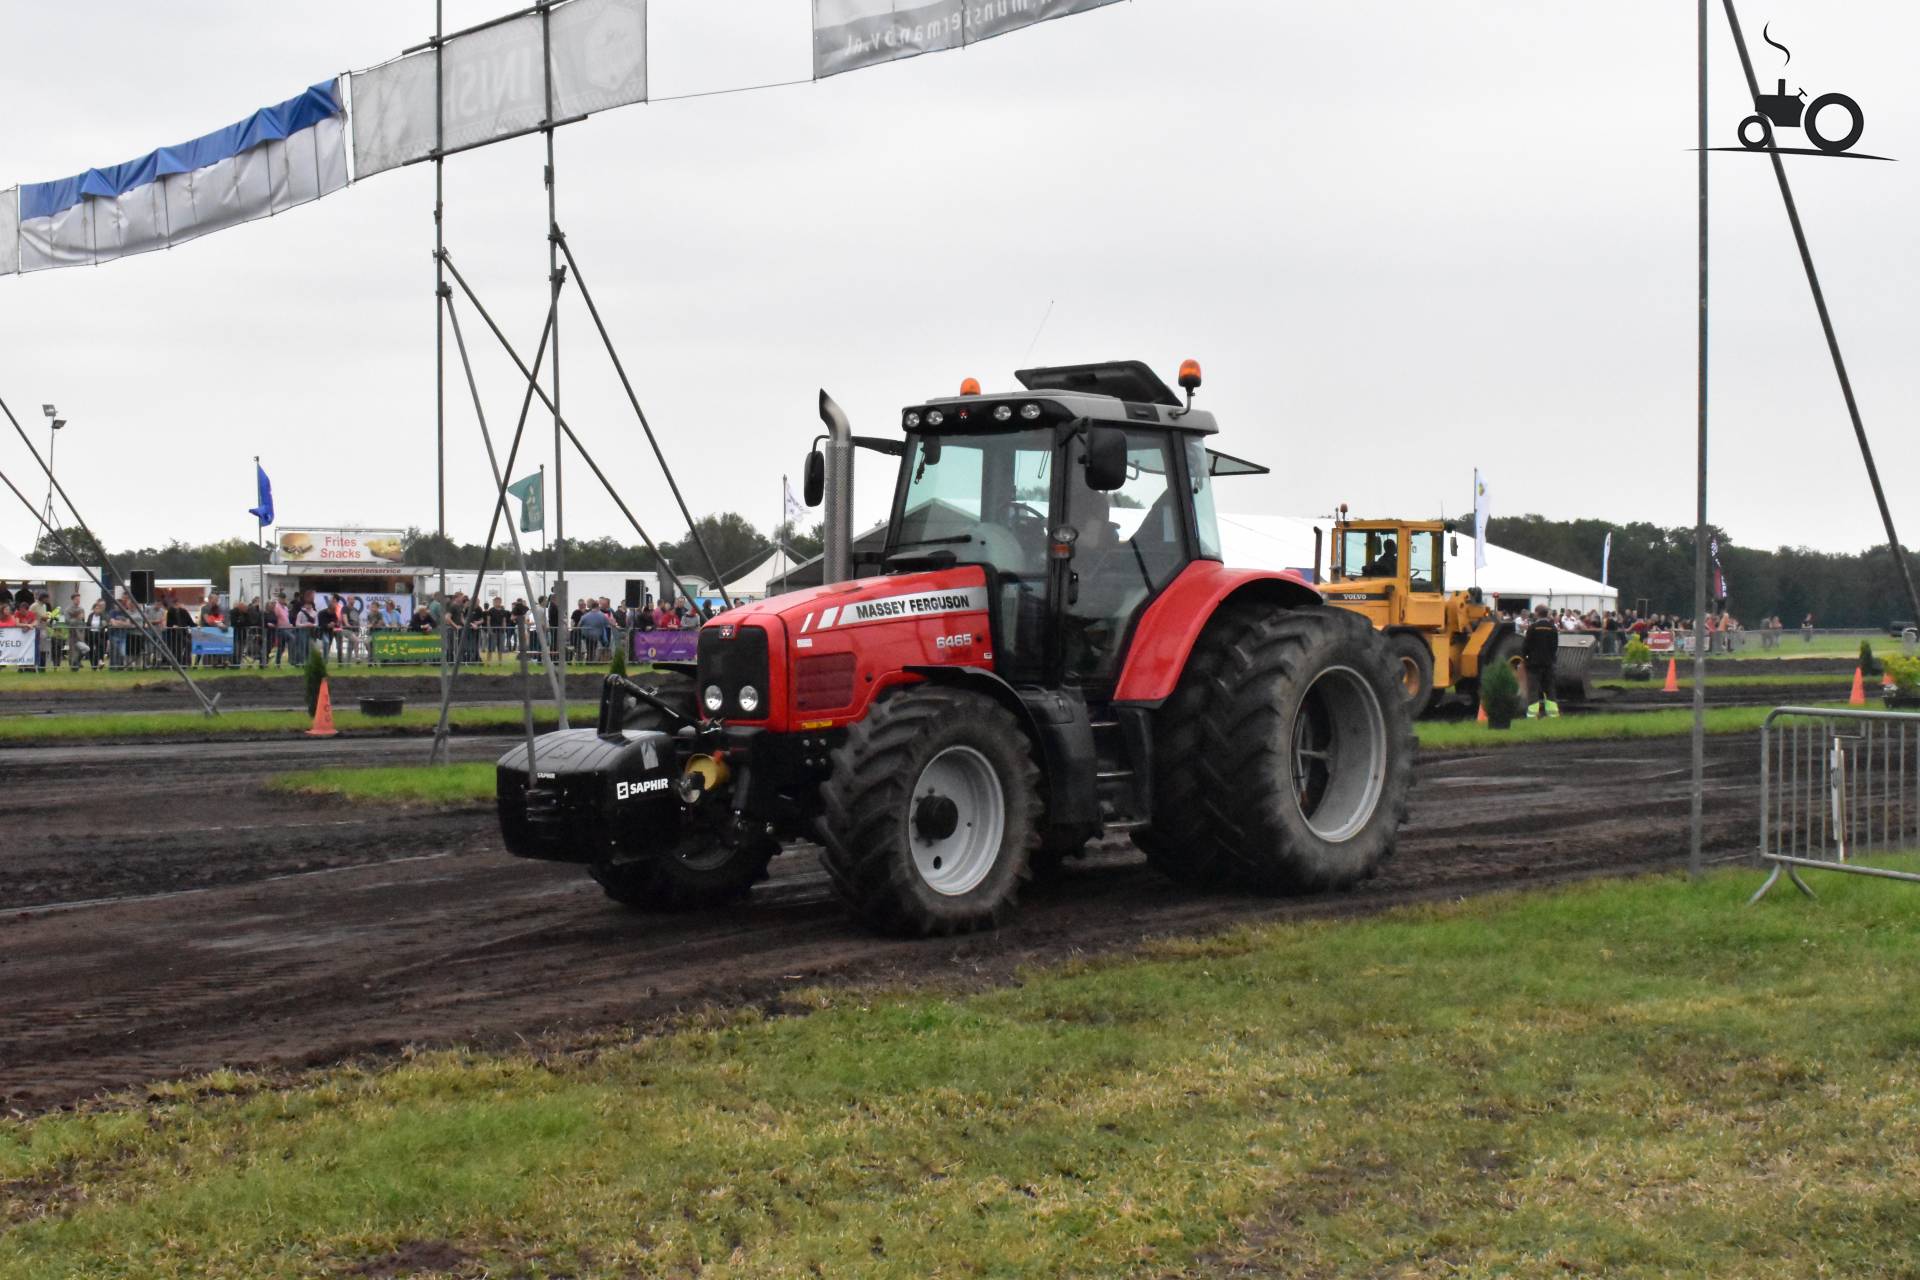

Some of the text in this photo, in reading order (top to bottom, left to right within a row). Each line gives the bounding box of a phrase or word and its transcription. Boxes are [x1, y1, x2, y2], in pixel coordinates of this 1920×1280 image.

[325, 536, 357, 547] Frites
[320, 548, 361, 559] Snacks
[856, 595, 970, 619] MASSEY FERGUSON
[936, 633, 973, 649] 6465
[630, 778, 669, 795] SAPHIR
